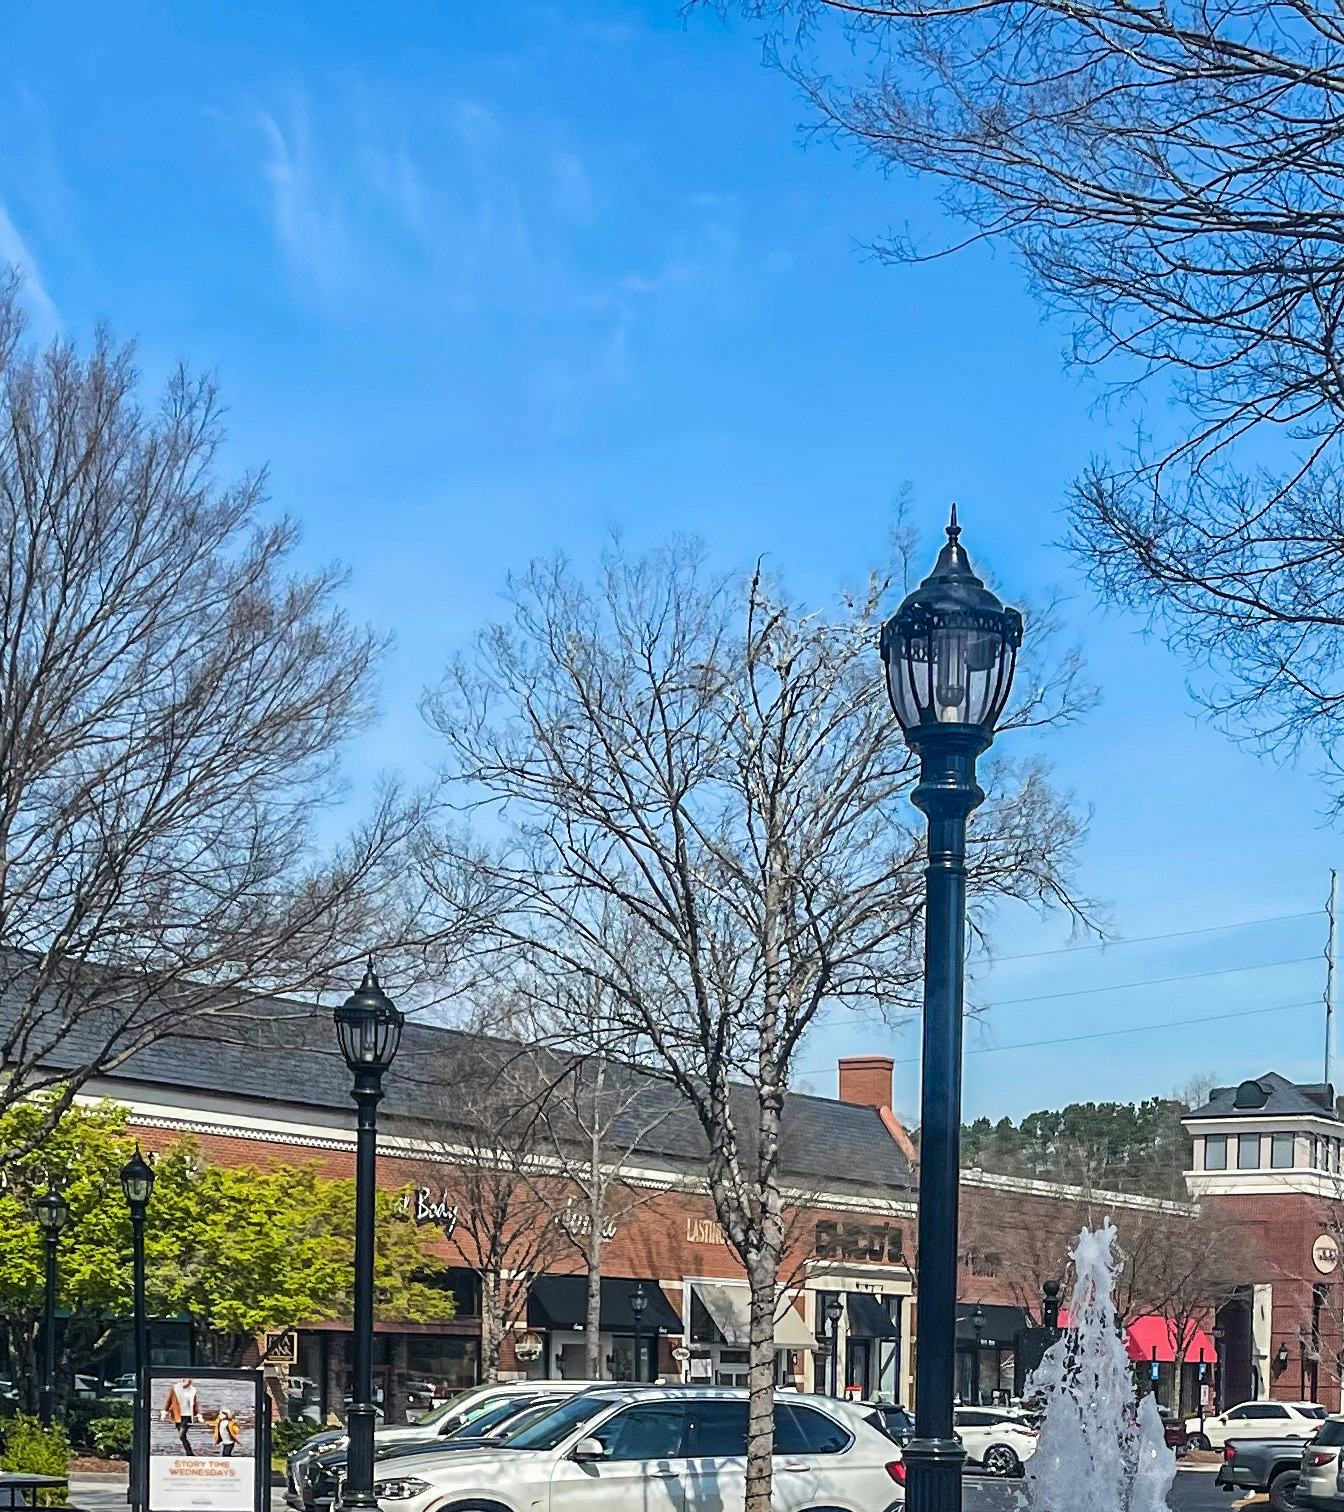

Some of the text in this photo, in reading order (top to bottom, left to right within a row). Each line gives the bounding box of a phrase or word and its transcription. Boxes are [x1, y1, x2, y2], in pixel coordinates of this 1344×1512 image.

[174, 1460, 230, 1469] STORY TIME
[169, 1468, 235, 1477] WEDNESDAYS
